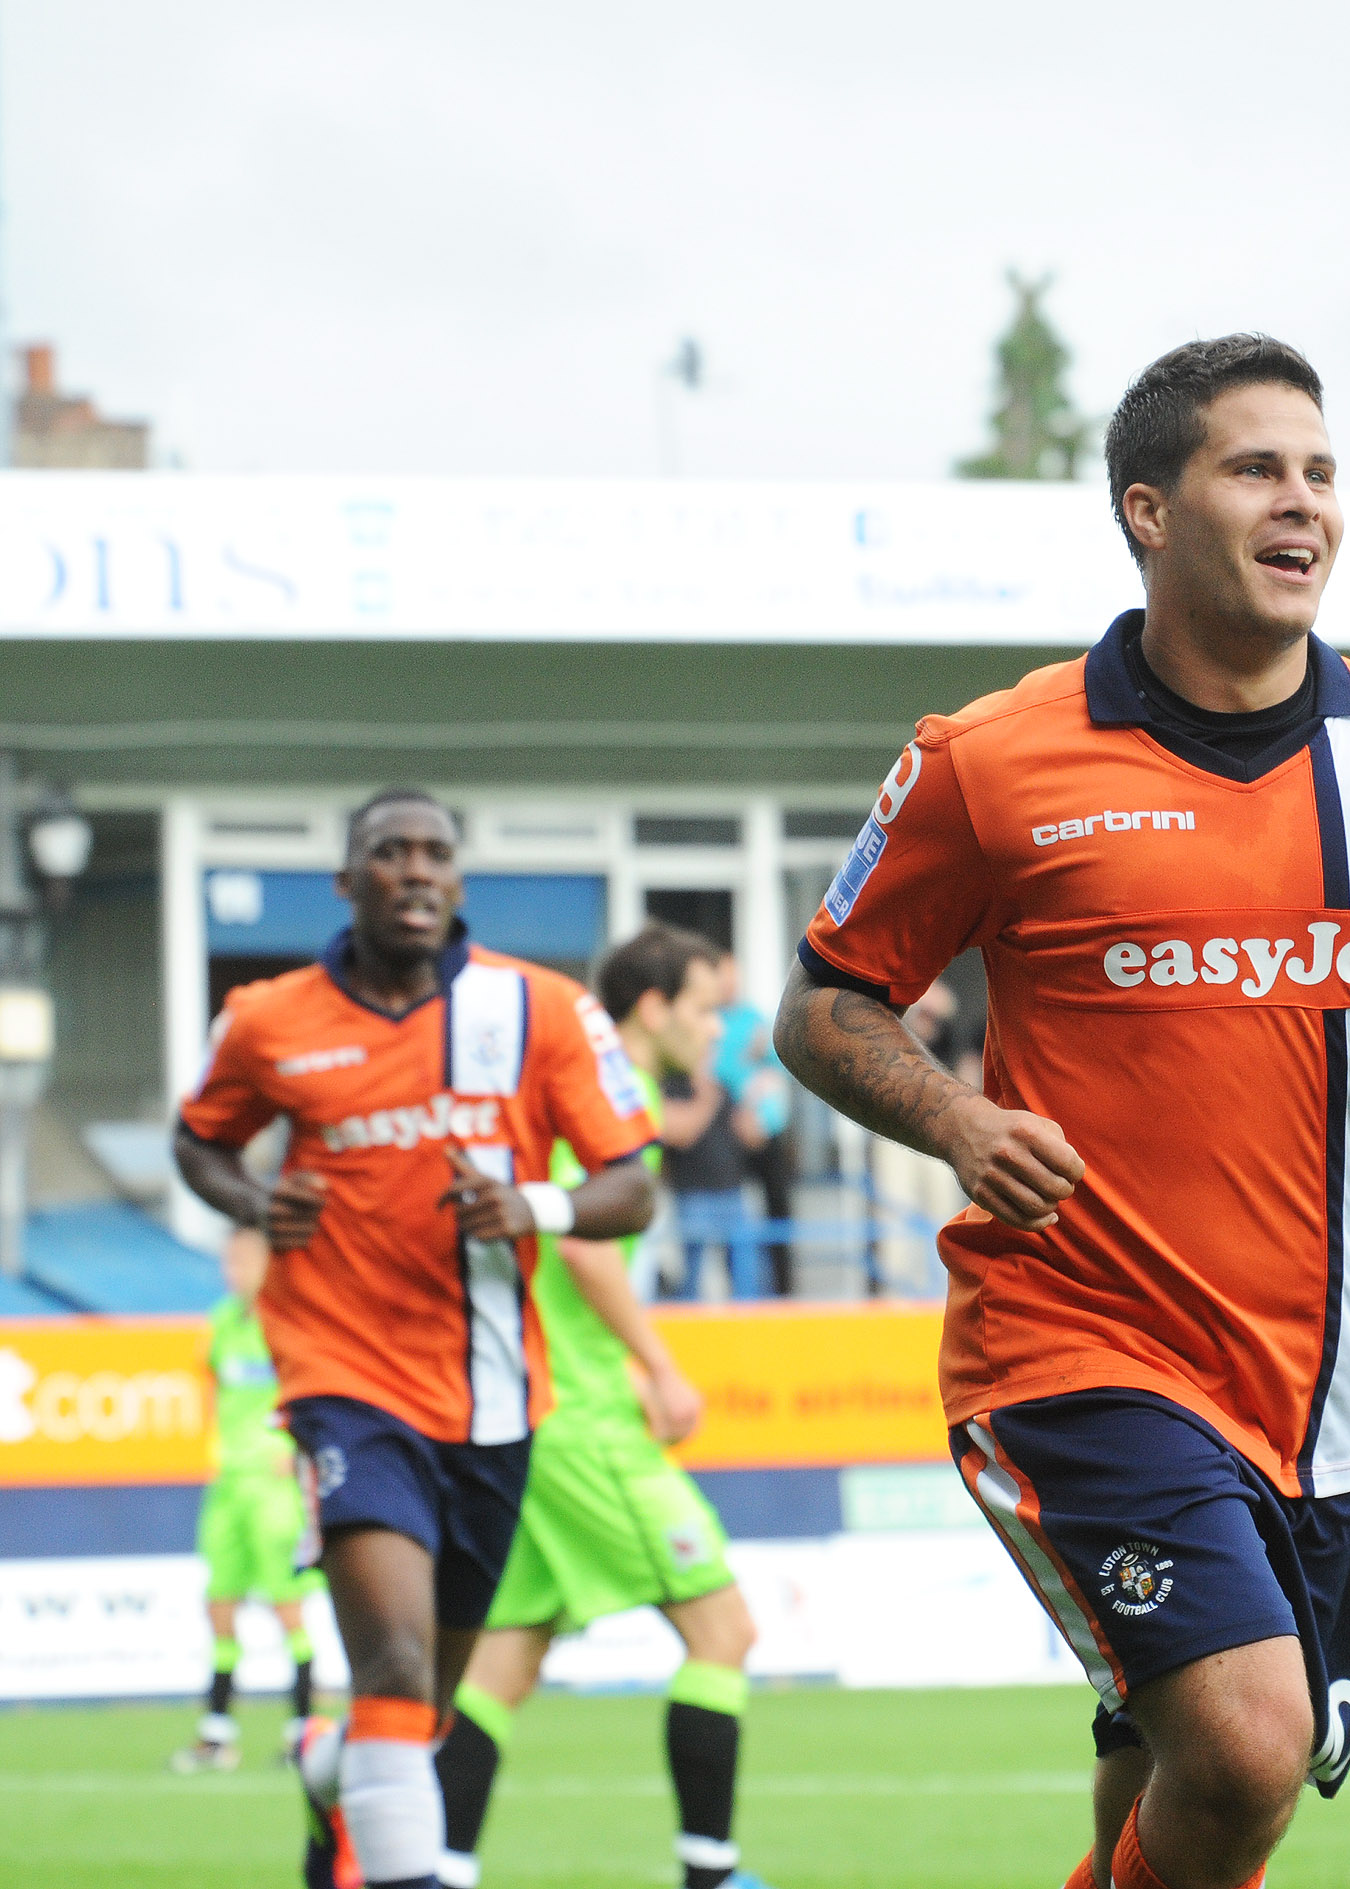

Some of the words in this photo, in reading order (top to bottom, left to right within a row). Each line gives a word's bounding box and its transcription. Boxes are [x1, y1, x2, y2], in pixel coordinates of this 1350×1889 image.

[1031, 809, 1195, 846] carbrini
[1099, 1545, 1127, 1576] LUTON
[1127, 1542, 1160, 1557] TOWN
[1100, 1583, 1115, 1596] EST
[1112, 1600, 1159, 1616] FOOTBALL
[1155, 1578, 1174, 1602] CLUB
